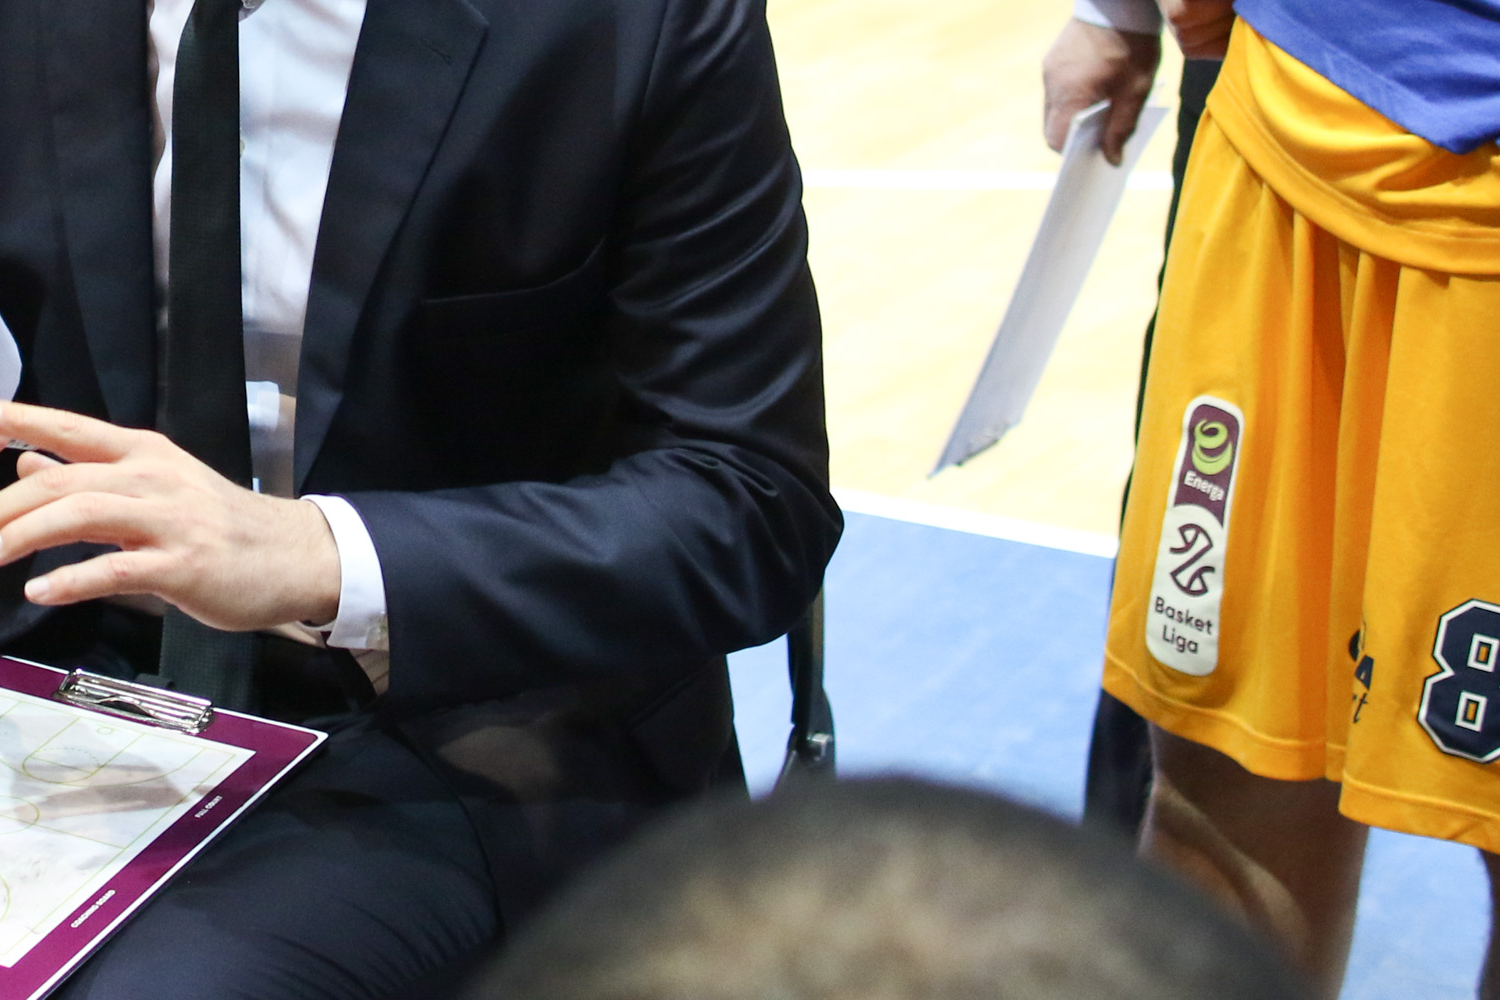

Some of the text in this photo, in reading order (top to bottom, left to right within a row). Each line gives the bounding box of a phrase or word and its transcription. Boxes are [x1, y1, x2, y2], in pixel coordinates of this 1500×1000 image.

[1183, 470, 1225, 502] Energa
[1155, 596, 1213, 635] Basket
[1162, 624, 1199, 655] Liga
[1417, 598, 1500, 764] 8
